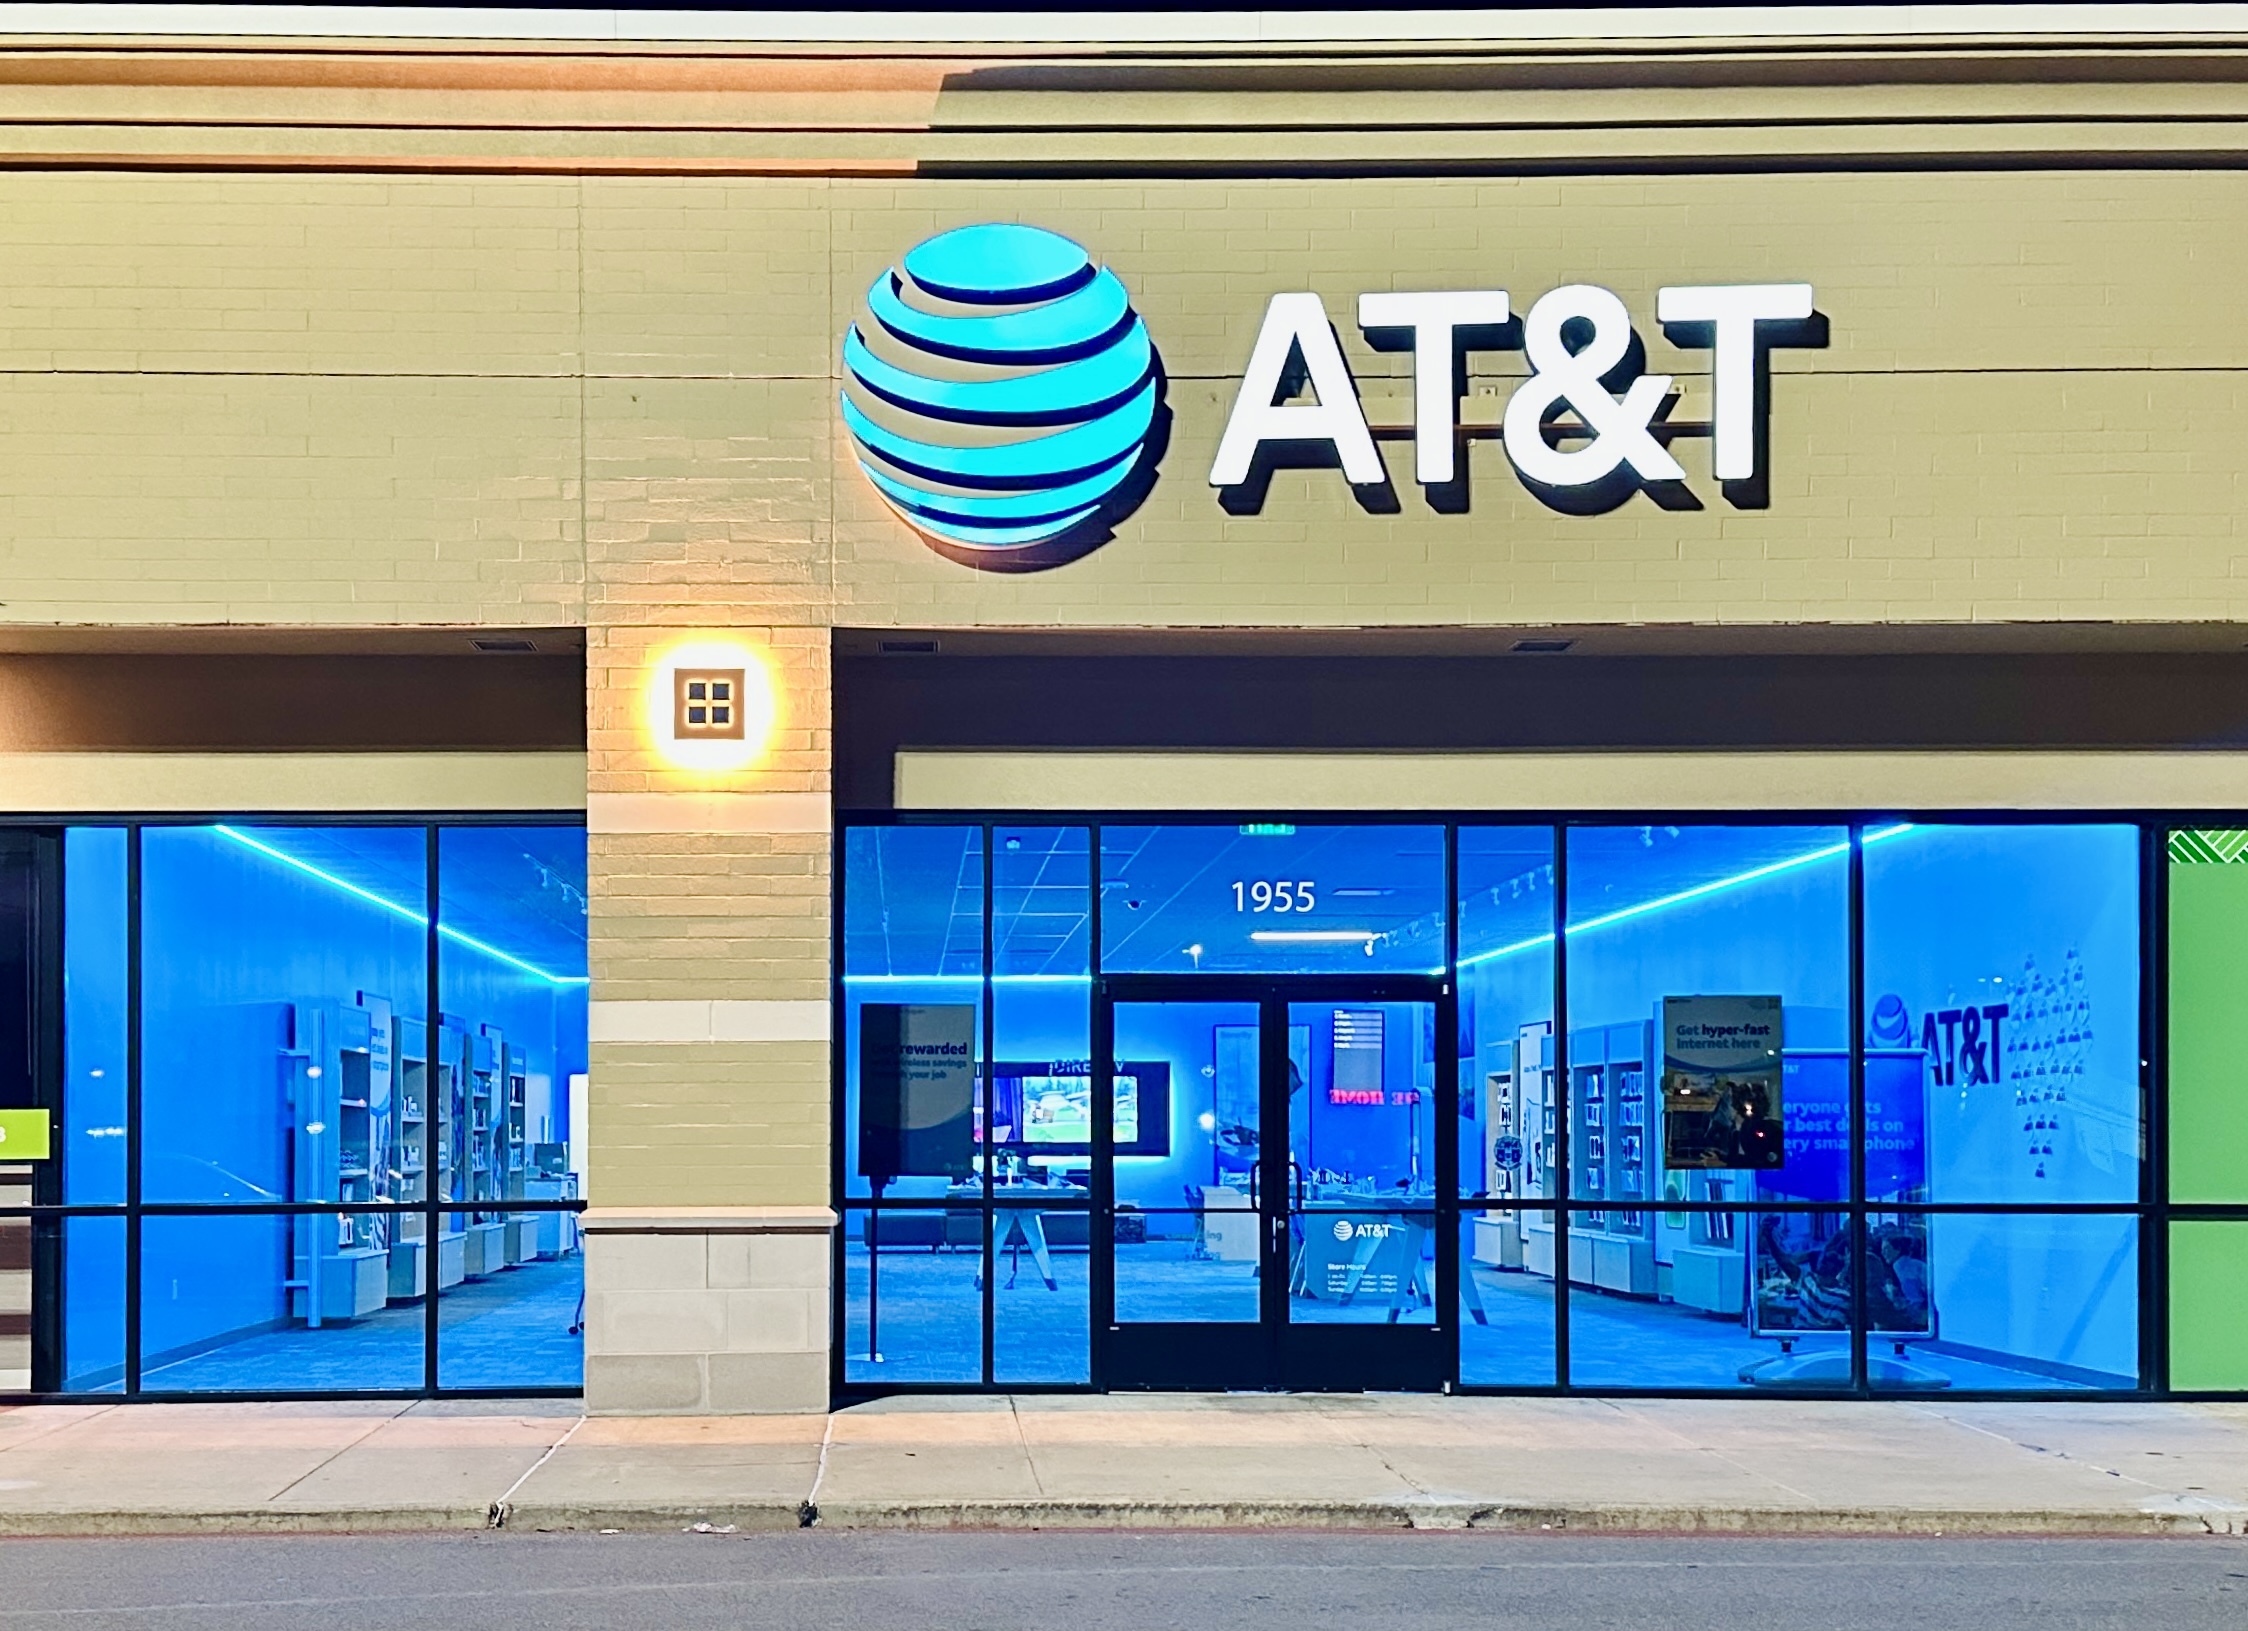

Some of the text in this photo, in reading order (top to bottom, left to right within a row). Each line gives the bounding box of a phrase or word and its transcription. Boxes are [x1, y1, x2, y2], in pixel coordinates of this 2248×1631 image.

[1209, 283, 1813, 487] AT&T
[1231, 880, 1315, 913] 1955
[1676, 1023, 1771, 1038] Get hyper-fast
[899, 1041, 968, 1055] rewarded
[1676, 1037, 1761, 1049] Internet here
[1921, 1003, 2009, 1087] AT&T
[932, 1058, 967, 1069] savings
[1054, 1059, 1125, 1073] DIREV
[1783, 1064, 1800, 1074] T&T
[908, 1071, 930, 1080] your
[931, 1069, 947, 1080] job
[1783, 1101, 1841, 1118] eryone
[1795, 1117, 1832, 1132] best
[1835, 1117, 1880, 1132] dls
[1882, 1120, 1904, 1132] on
[1784, 1135, 1916, 1152] ery smaphone
[1355, 1224, 1390, 1238] AT&T
